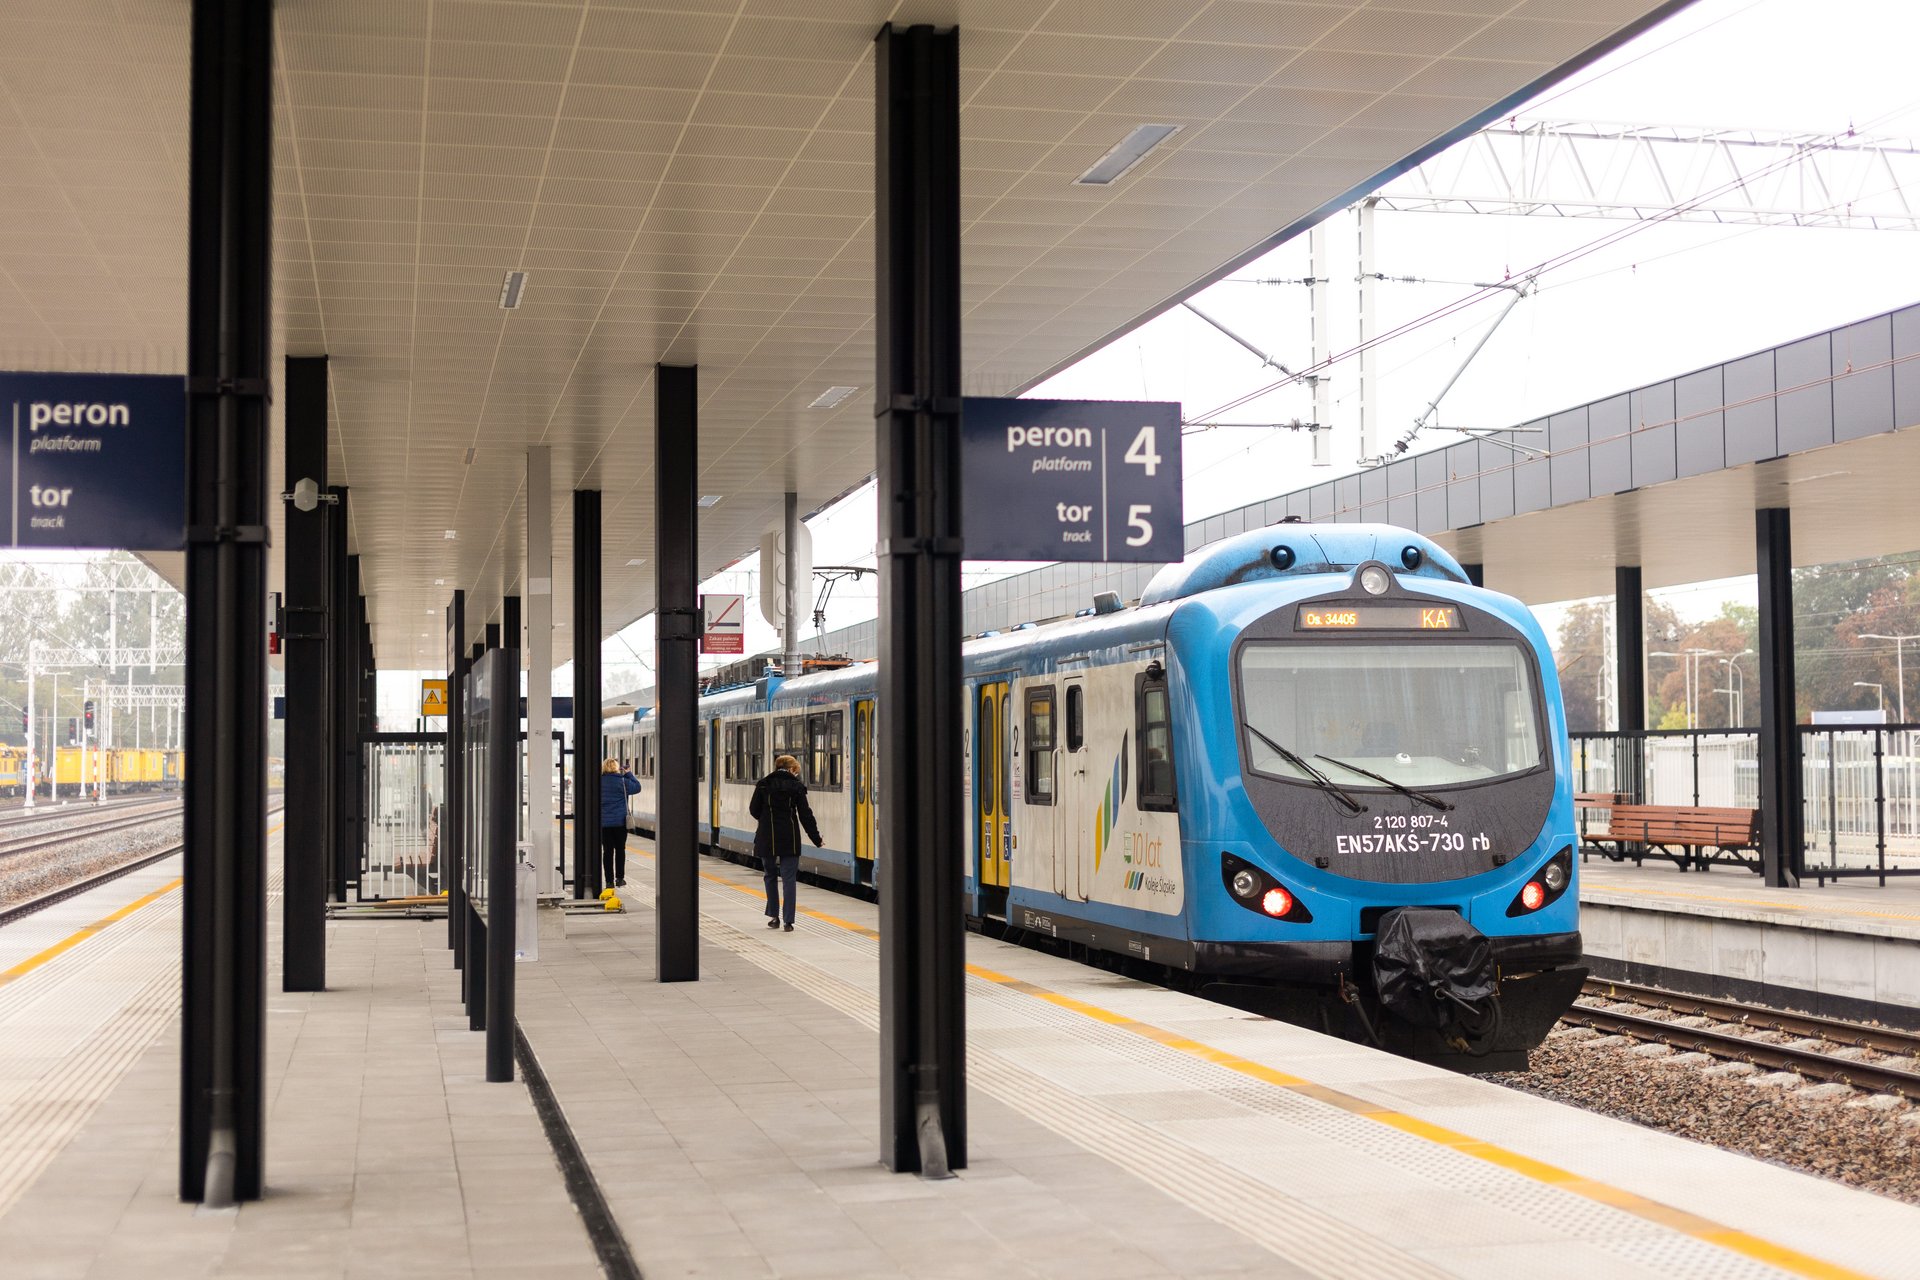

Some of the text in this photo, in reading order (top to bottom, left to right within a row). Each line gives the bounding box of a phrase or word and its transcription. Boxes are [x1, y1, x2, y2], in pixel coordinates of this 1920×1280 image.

[29, 402, 130, 432] peron
[30, 434, 102, 453] platform
[1007, 426, 1092, 452] peron
[1124, 426, 1161, 476] 4
[1032, 456, 1092, 473] platform
[29, 484, 73, 507] tor
[30, 515, 65, 529] track
[1056, 502, 1092, 522] tor
[1062, 530, 1092, 543] track
[1126, 504, 1153, 546] 5
[1307, 614, 1323, 625] Os.
[965, 728, 970, 758] 2
[1013, 725, 1019, 757] 2
[1374, 815, 1449, 828] 2 120 807-4
[1133, 832, 1162, 867] 10 lat
[1336, 829, 1490, 854] EN57AKŚ-730 rb
